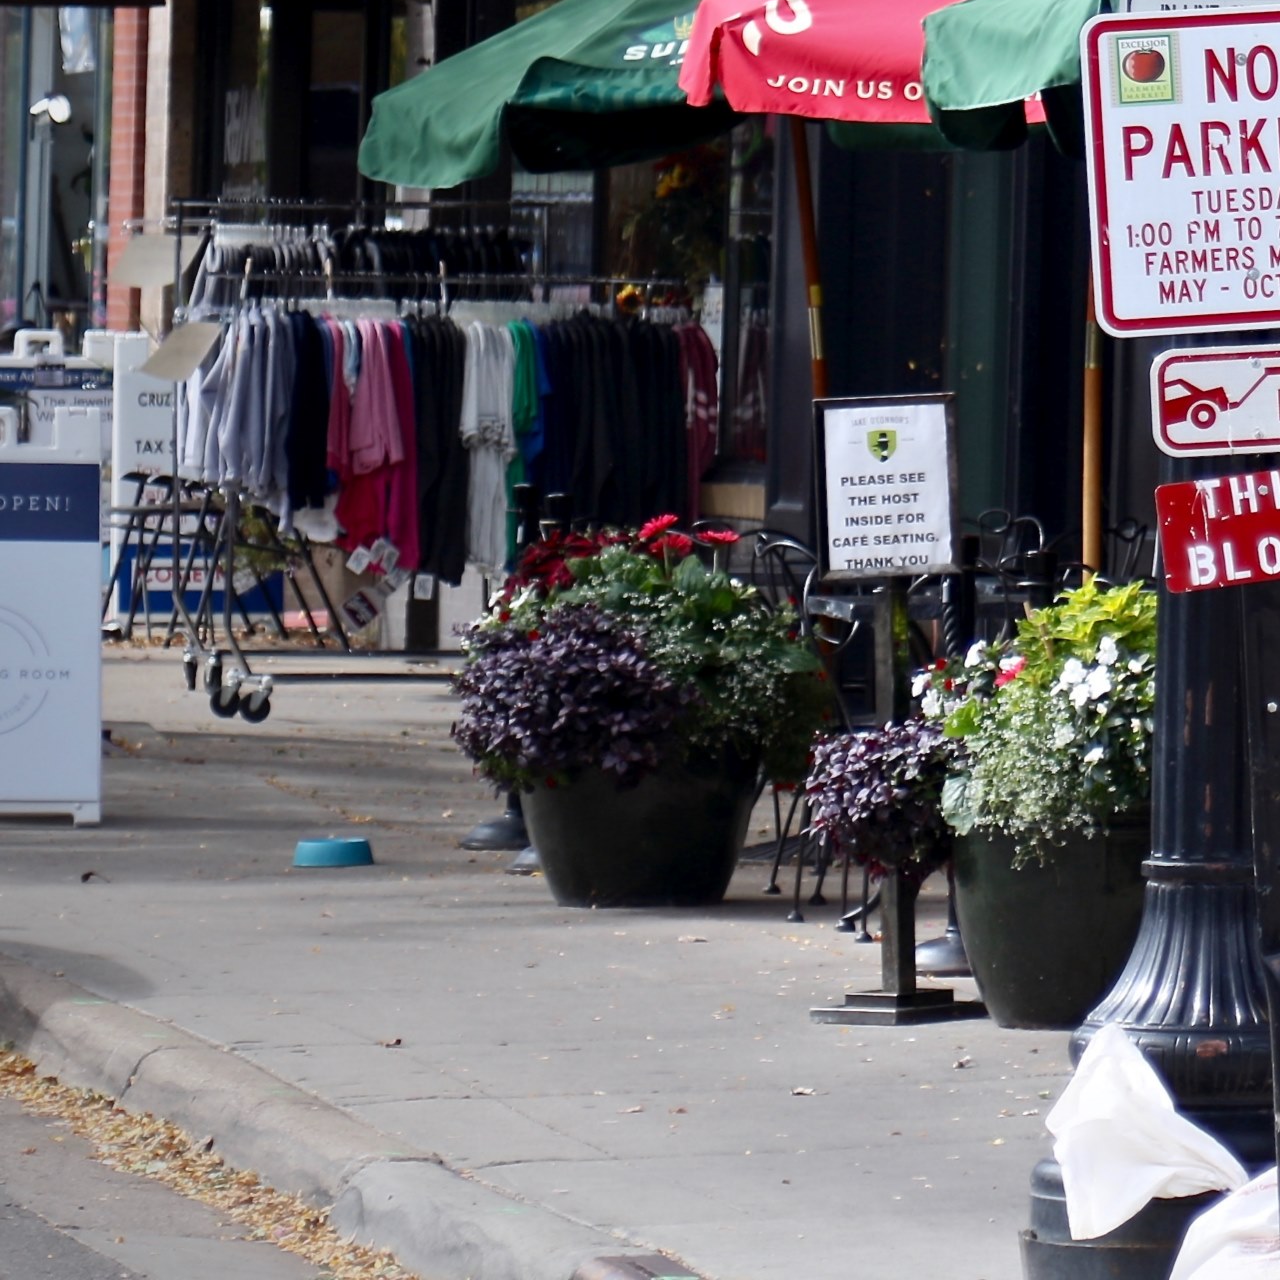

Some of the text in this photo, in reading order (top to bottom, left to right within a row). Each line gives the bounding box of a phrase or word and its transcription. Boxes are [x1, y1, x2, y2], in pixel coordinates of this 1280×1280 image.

[1121, 40, 1166, 49] EXCELSIOR
[1204, 44, 1279, 103] NO
[767, 75, 845, 97] JOIN
[856, 80, 893, 99] US
[1126, 222, 1172, 248] 1:00
[1188, 219, 1221, 244] PM
[1234, 218, 1262, 241] TO
[1144, 246, 1255, 276] FARMERS
[1158, 278, 1207, 304] MAY
[136, 440, 163, 454] TAX
[841, 472, 926, 486] PLEASE SEE
[849, 493, 919, 506] THE HOST
[845, 513, 925, 527] INSIDE FOR
[832, 533, 939, 548] CAFÉ SEATING.
[845, 555, 928, 570] THANK YOU
[20, 669, 71, 680] ROOM
